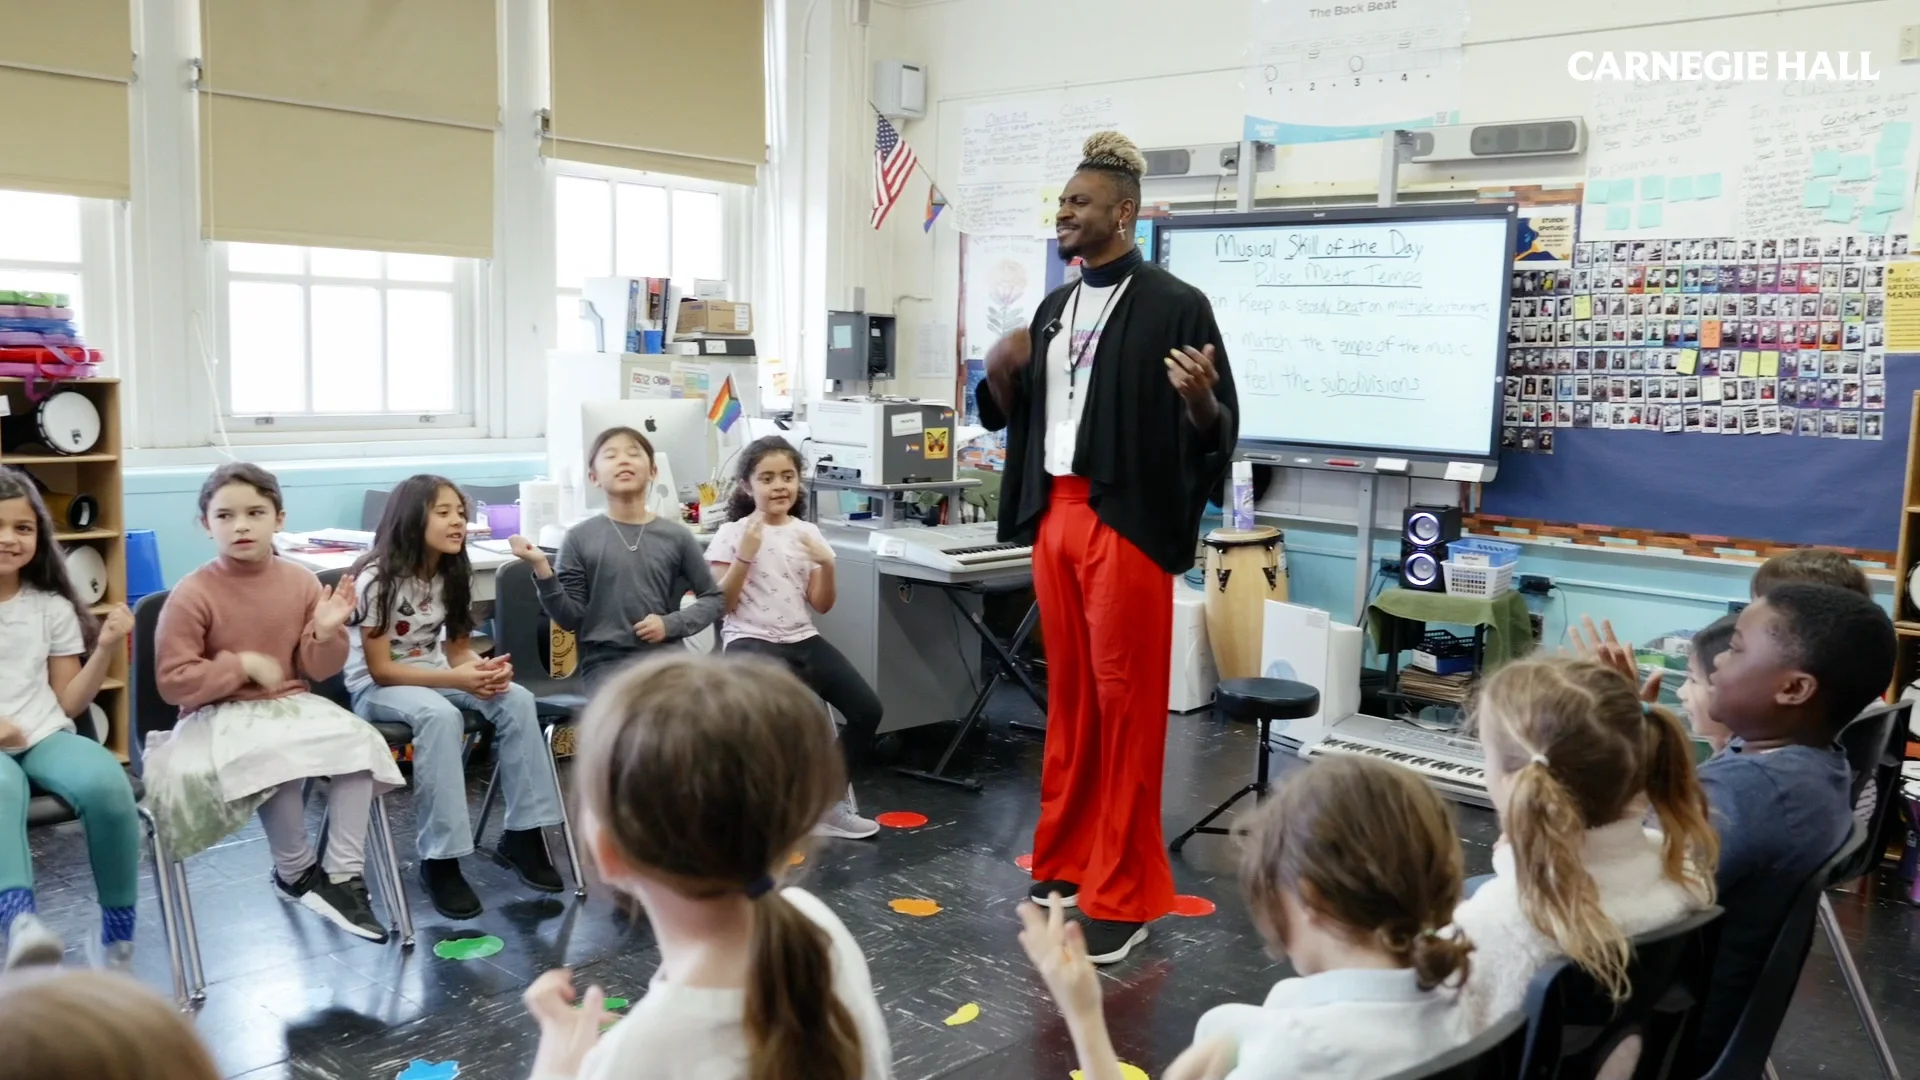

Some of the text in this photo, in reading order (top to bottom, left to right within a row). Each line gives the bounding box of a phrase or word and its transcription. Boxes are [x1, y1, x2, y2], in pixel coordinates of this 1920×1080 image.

[1309, 0, 1397, 19] The Back Beat
[1268, 73, 1408, 95] 1 2 3 4
[1216, 229, 1424, 262] Musical Skill of the Day
[1253, 261, 1293, 284] Pulse
[1364, 263, 1423, 284] Tempo
[1280, 299, 1291, 310] a
[1296, 296, 1331, 319] steady
[1337, 294, 1368, 312] beat
[1369, 302, 1383, 312] on
[1388, 296, 1434, 314] multiple
[1299, 333, 1325, 351] the
[1331, 335, 1372, 357] tempo
[1375, 335, 1396, 352] of
[1398, 338, 1420, 354] the
[1425, 341, 1473, 356] music
[1241, 358, 1420, 393] feel the subdivisions
